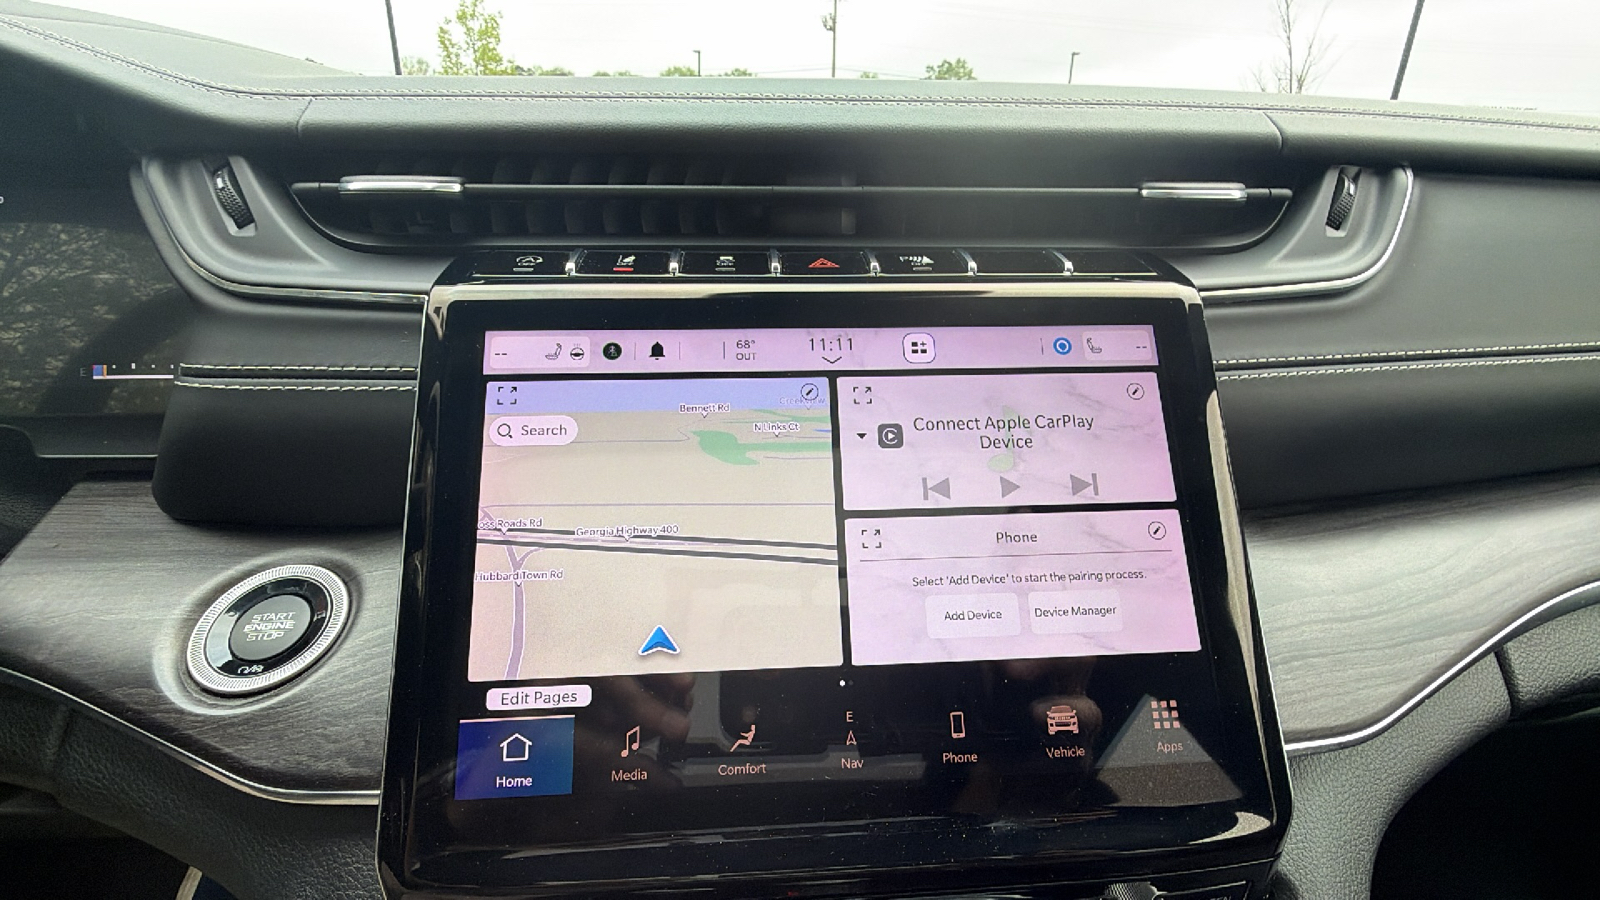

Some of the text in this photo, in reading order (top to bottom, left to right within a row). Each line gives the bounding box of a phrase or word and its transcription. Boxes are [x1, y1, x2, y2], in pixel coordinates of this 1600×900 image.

[809, 338, 853, 351] 11:11
[680, 403, 730, 412] Bennett Rd
[764, 423, 786, 431] Links
[788, 422, 800, 430] Ct
[913, 415, 1094, 432] Connect Apple CarPlay
[520, 424, 568, 436] Search
[980, 436, 1034, 449] Device
[498, 519, 526, 528] Roads
[529, 518, 542, 527] Rd
[576, 525, 679, 538] Georgia Highway 400
[996, 532, 1038, 544] Phone
[475, 570, 564, 581] Hubbard Town Rd
[912, 570, 1147, 587] Select 'Add Device' to start the pairing process.
[252, 612, 296, 621] START
[944, 610, 1002, 621] Add Device
[1034, 606, 1117, 618] Device Manager
[244, 621, 296, 632] ENGINE
[246, 632, 284, 642] STOP
[500, 691, 578, 706] Edit Pages
[846, 711, 854, 722] E
[1046, 746, 1086, 758] Vehicle
[1156, 741, 1184, 754] Apps
[841, 758, 864, 768] Nav
[942, 752, 978, 764] Phone
[611, 769, 648, 782] Media
[718, 763, 766, 776] Comfort
[496, 776, 533, 788] Home
